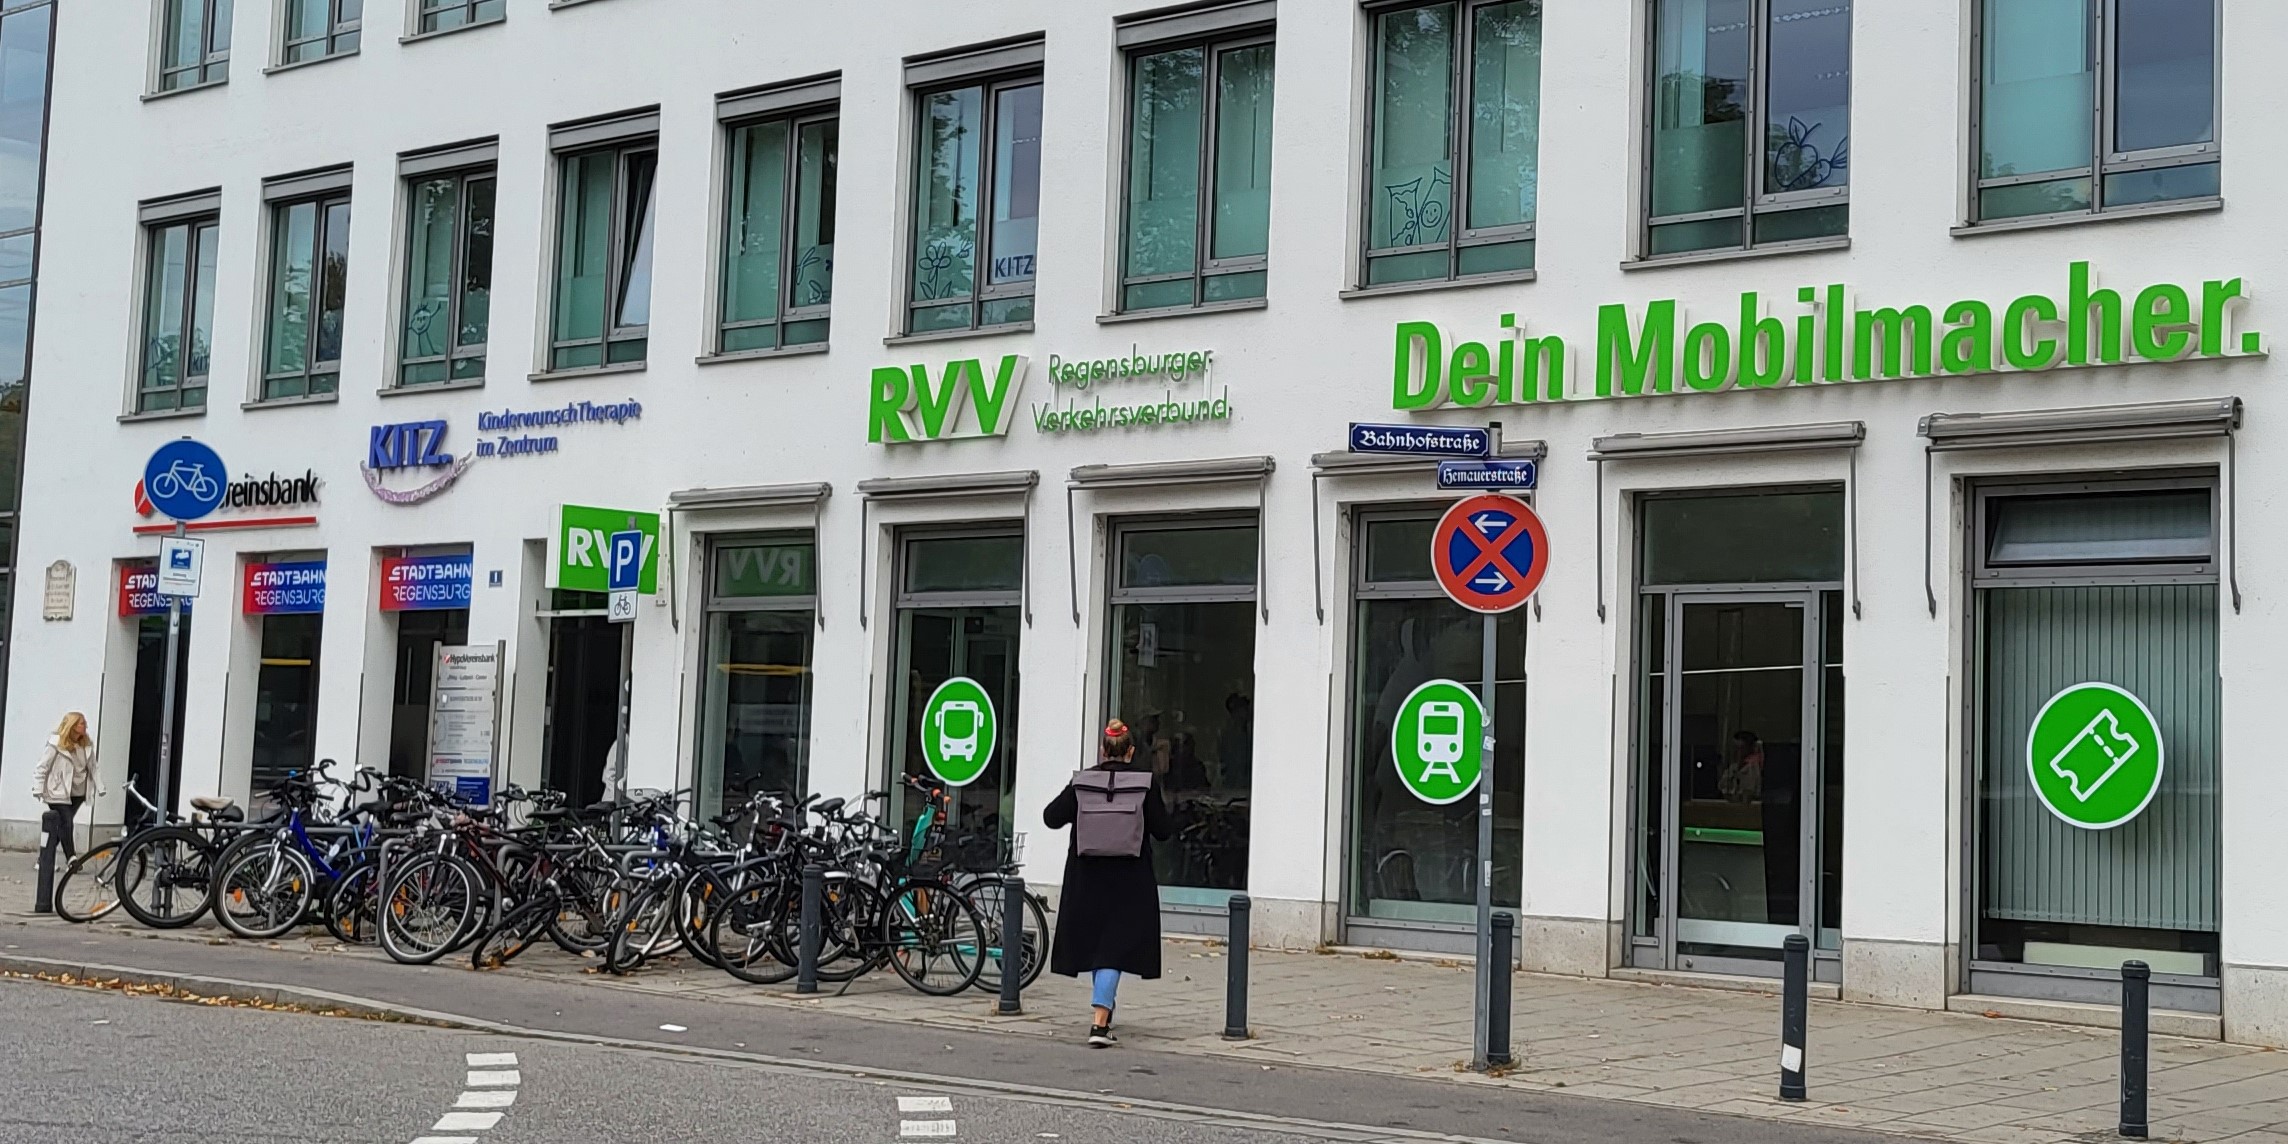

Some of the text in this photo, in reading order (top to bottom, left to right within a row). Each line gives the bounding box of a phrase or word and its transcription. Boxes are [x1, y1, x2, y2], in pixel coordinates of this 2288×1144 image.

[995, 254, 1034, 278] KITZ
[1393, 261, 2261, 409] Dein Mobilmacher.
[1048, 343, 1212, 391] Regensburger
[869, 356, 1018, 443] RVV
[1032, 385, 1232, 434] Verkehrsverbund
[477, 434, 558, 457] im Zentrum
[1359, 430, 1480, 452] Bahnhofstraße
[1443, 466, 1527, 485] Hemauerstraße
[219, 468, 318, 509] reinsbank
[616, 539, 634, 582] P
[125, 574, 158, 590] STAD
[250, 569, 326, 587] STADTBAHN
[388, 563, 472, 581] STADTBAHN
[128, 592, 192, 608] REGENSBG
[254, 588, 325, 606] REGENSBURG
[392, 583, 471, 602] REGENSBURG
